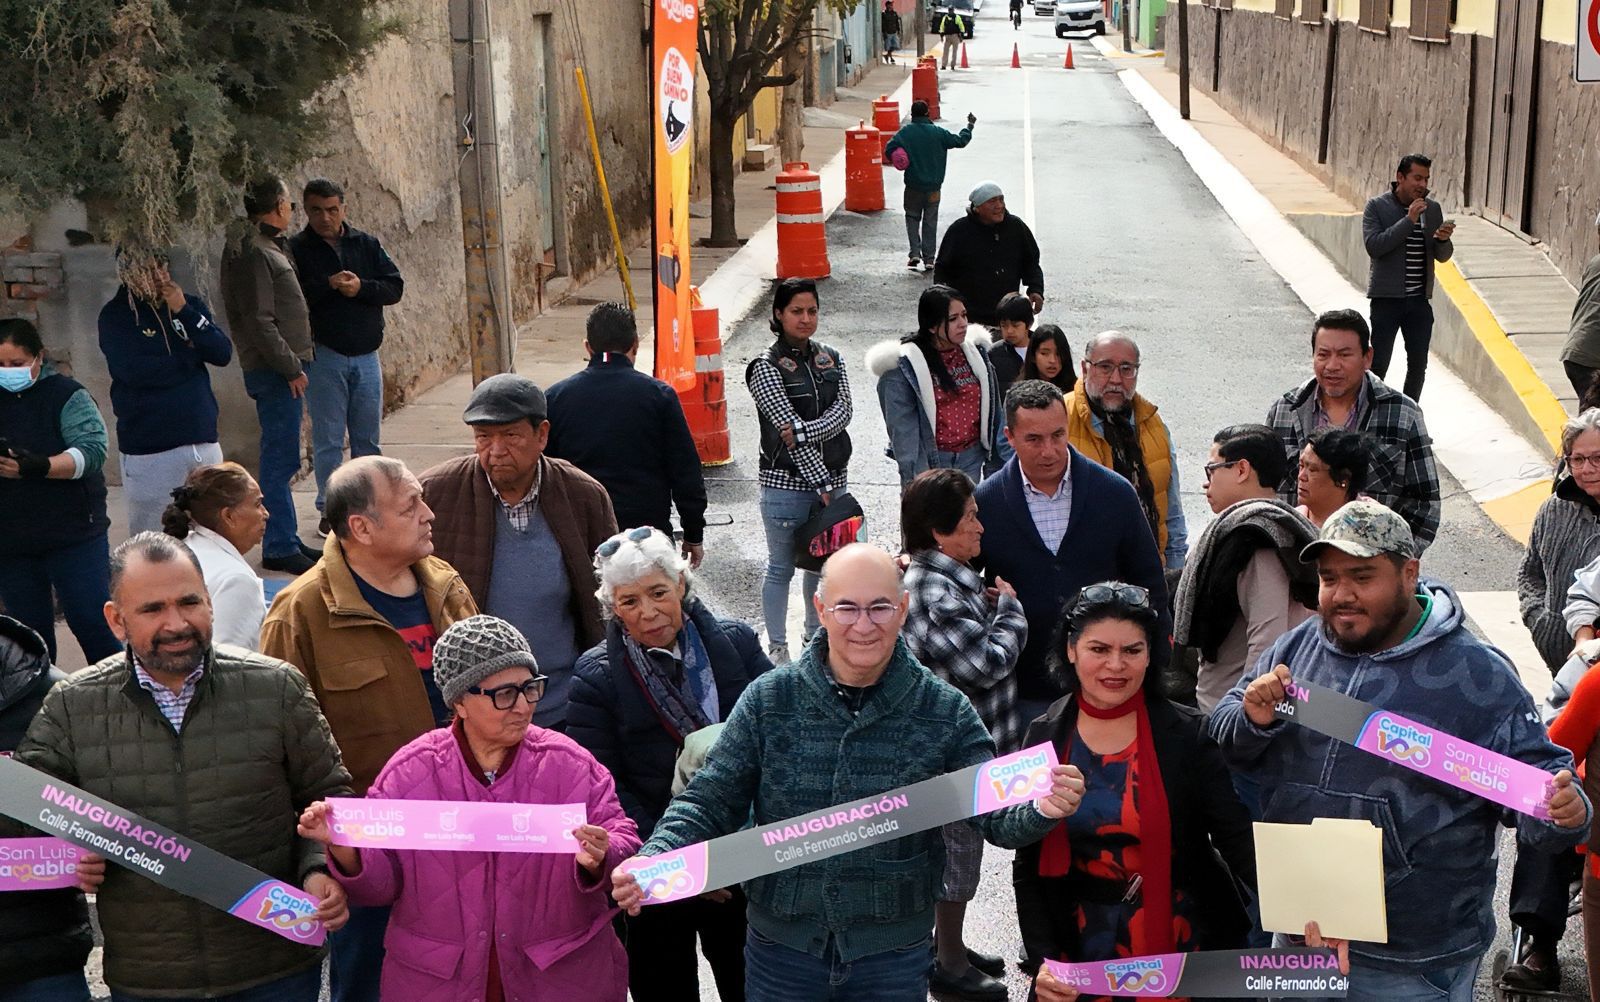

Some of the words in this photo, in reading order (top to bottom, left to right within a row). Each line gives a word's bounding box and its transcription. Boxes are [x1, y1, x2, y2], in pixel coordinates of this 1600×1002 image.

[1380, 718, 1431, 747] Capital
[989, 751, 1047, 778] Capital
[1444, 742, 1475, 766] San
[1478, 755, 1511, 778] Luis
[41, 784, 192, 863] INAUGURACIÓN
[368, 806, 405, 822] Luis
[560, 811, 584, 826] Sa
[762, 794, 909, 847] INAUGURACIÓN
[0, 846, 35, 861] San
[40, 844, 77, 860] Luis
[39, 808, 69, 831] Calle
[68, 820, 124, 856] Fernando
[123, 847, 166, 875] Celada
[774, 844, 804, 863] Calle
[803, 829, 858, 856] Fernando
[858, 818, 899, 840] Celada
[1104, 960, 1162, 974] Capital
[1239, 954, 1340, 970] INAUGURA
[1245, 975, 1273, 990] Calle
[1275, 975, 1327, 991] Fernando
